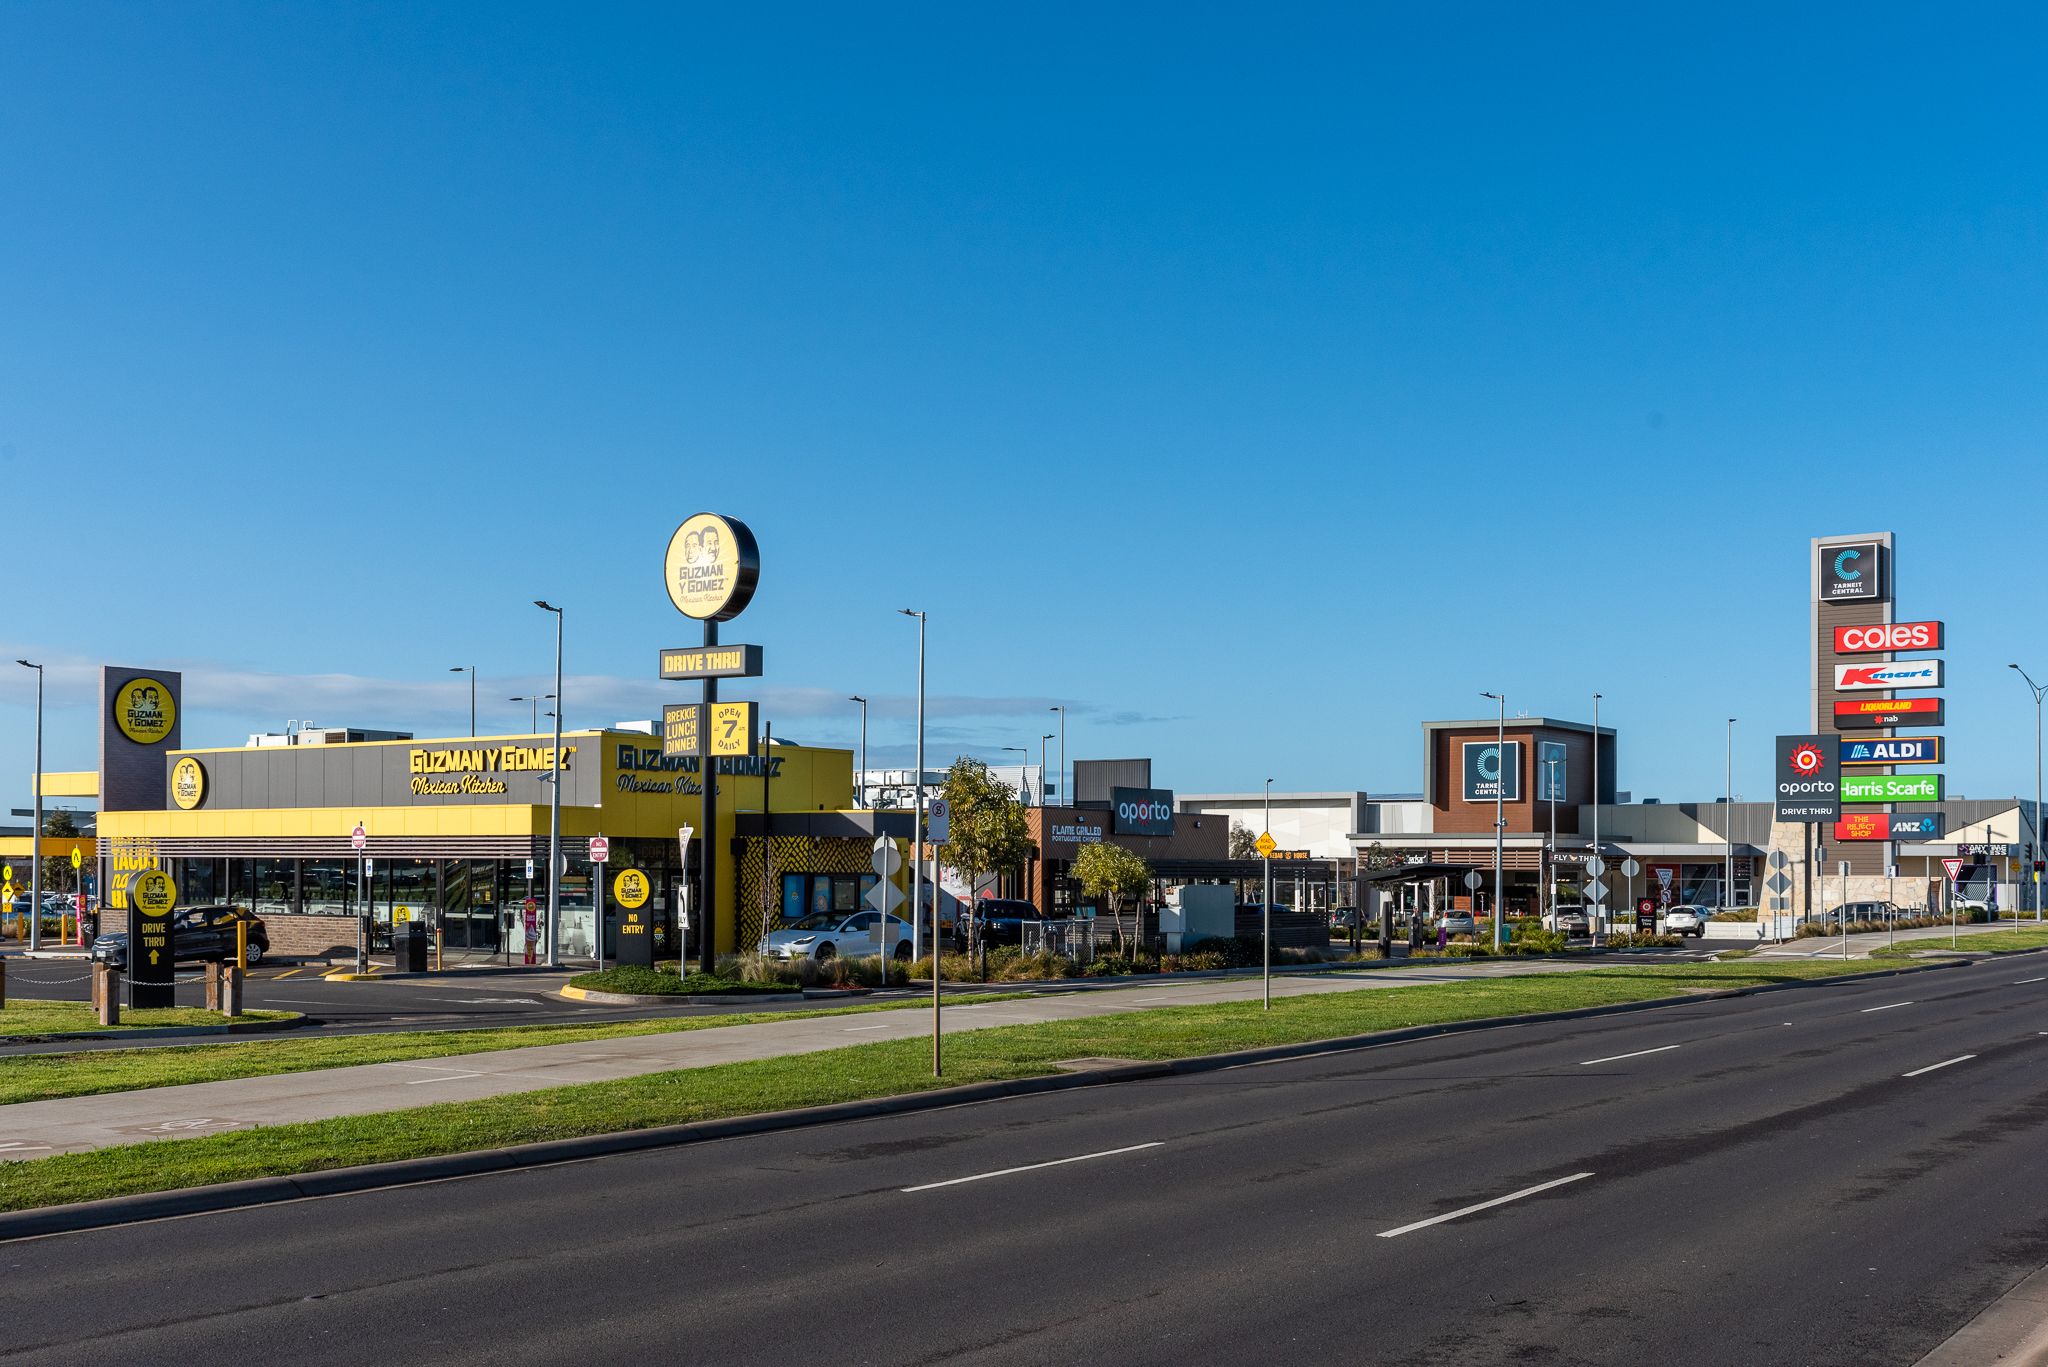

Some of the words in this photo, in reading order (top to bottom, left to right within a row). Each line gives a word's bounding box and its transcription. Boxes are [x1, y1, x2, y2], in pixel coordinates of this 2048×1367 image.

[680, 564, 724, 580] GUZMAN
[679, 582, 686, 594] Y
[1843, 625, 1929, 650] coles
[664, 654, 703, 673] DRIVE
[706, 651, 740, 670] THRU
[1840, 667, 1933, 686] Kmart
[127, 709, 163, 718] GUZMAN
[718, 708, 741, 719] OPEN
[1860, 702, 1912, 712] LIQUORLAND
[666, 706, 696, 724] BREKKIE
[127, 719, 134, 727] Y
[666, 720, 697, 740] LUNCH
[722, 720, 738, 739] 7
[666, 736, 697, 754] DINNER
[718, 739, 741, 751] DAILY
[1872, 743, 1923, 760] ALDI
[409, 749, 484, 774] GUZMAN
[485, 749, 501, 772] Y
[410, 776, 460, 796] Mexican
[461, 774, 509, 795] Kitchen
[616, 774, 674, 794] Mexican
[1779, 781, 1835, 796] oporto
[1886, 780, 1934, 796] Scarfe
[1119, 800, 1170, 824] oporto
[1853, 815, 1869, 824] THE
[1052, 825, 1075, 835] FLAME
[1076, 826, 1102, 836] GRILLED
[1846, 822, 1876, 832] REJECT
[1851, 829, 1872, 838] SHOP
[1892, 822, 1921, 833] ANZ
[111, 848, 159, 871] TACOS
[628, 913, 638, 923] NO
[142, 923, 167, 934] DRIVE
[622, 924, 644, 934] ENTRY
[143, 936, 166, 947] THRU
